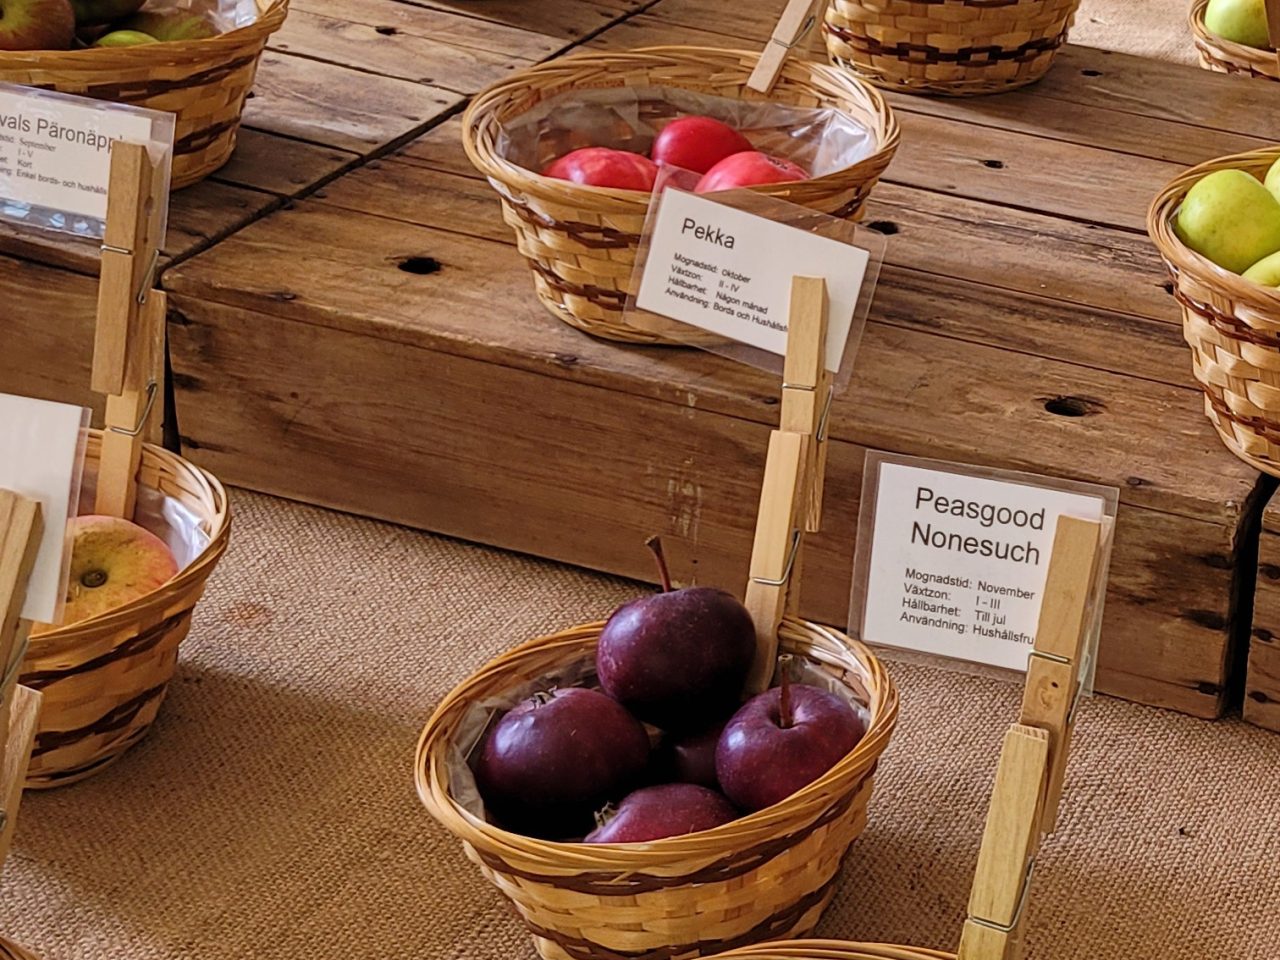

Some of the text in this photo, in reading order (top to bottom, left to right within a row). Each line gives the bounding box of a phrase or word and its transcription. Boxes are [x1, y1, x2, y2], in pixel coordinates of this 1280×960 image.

[36, 118, 123, 154] Päronäpp
[62, 180, 76, 189] och
[681, 218, 735, 249] Pekka
[674, 252, 752, 283] Mognadstid: Oktober
[713, 302, 735, 316] Bords
[736, 311, 751, 321] och
[716, 291, 741, 304] Någon
[742, 301, 769, 315] månad
[915, 486, 1046, 531] Peasgood
[911, 521, 1040, 565] Nonesuch
[903, 583, 952, 600] Växtzon:
[905, 567, 1036, 600] Mognadstid: November
[900, 611, 969, 635] Användning:
[902, 597, 1007, 626] Hållbarhet: Till jul
